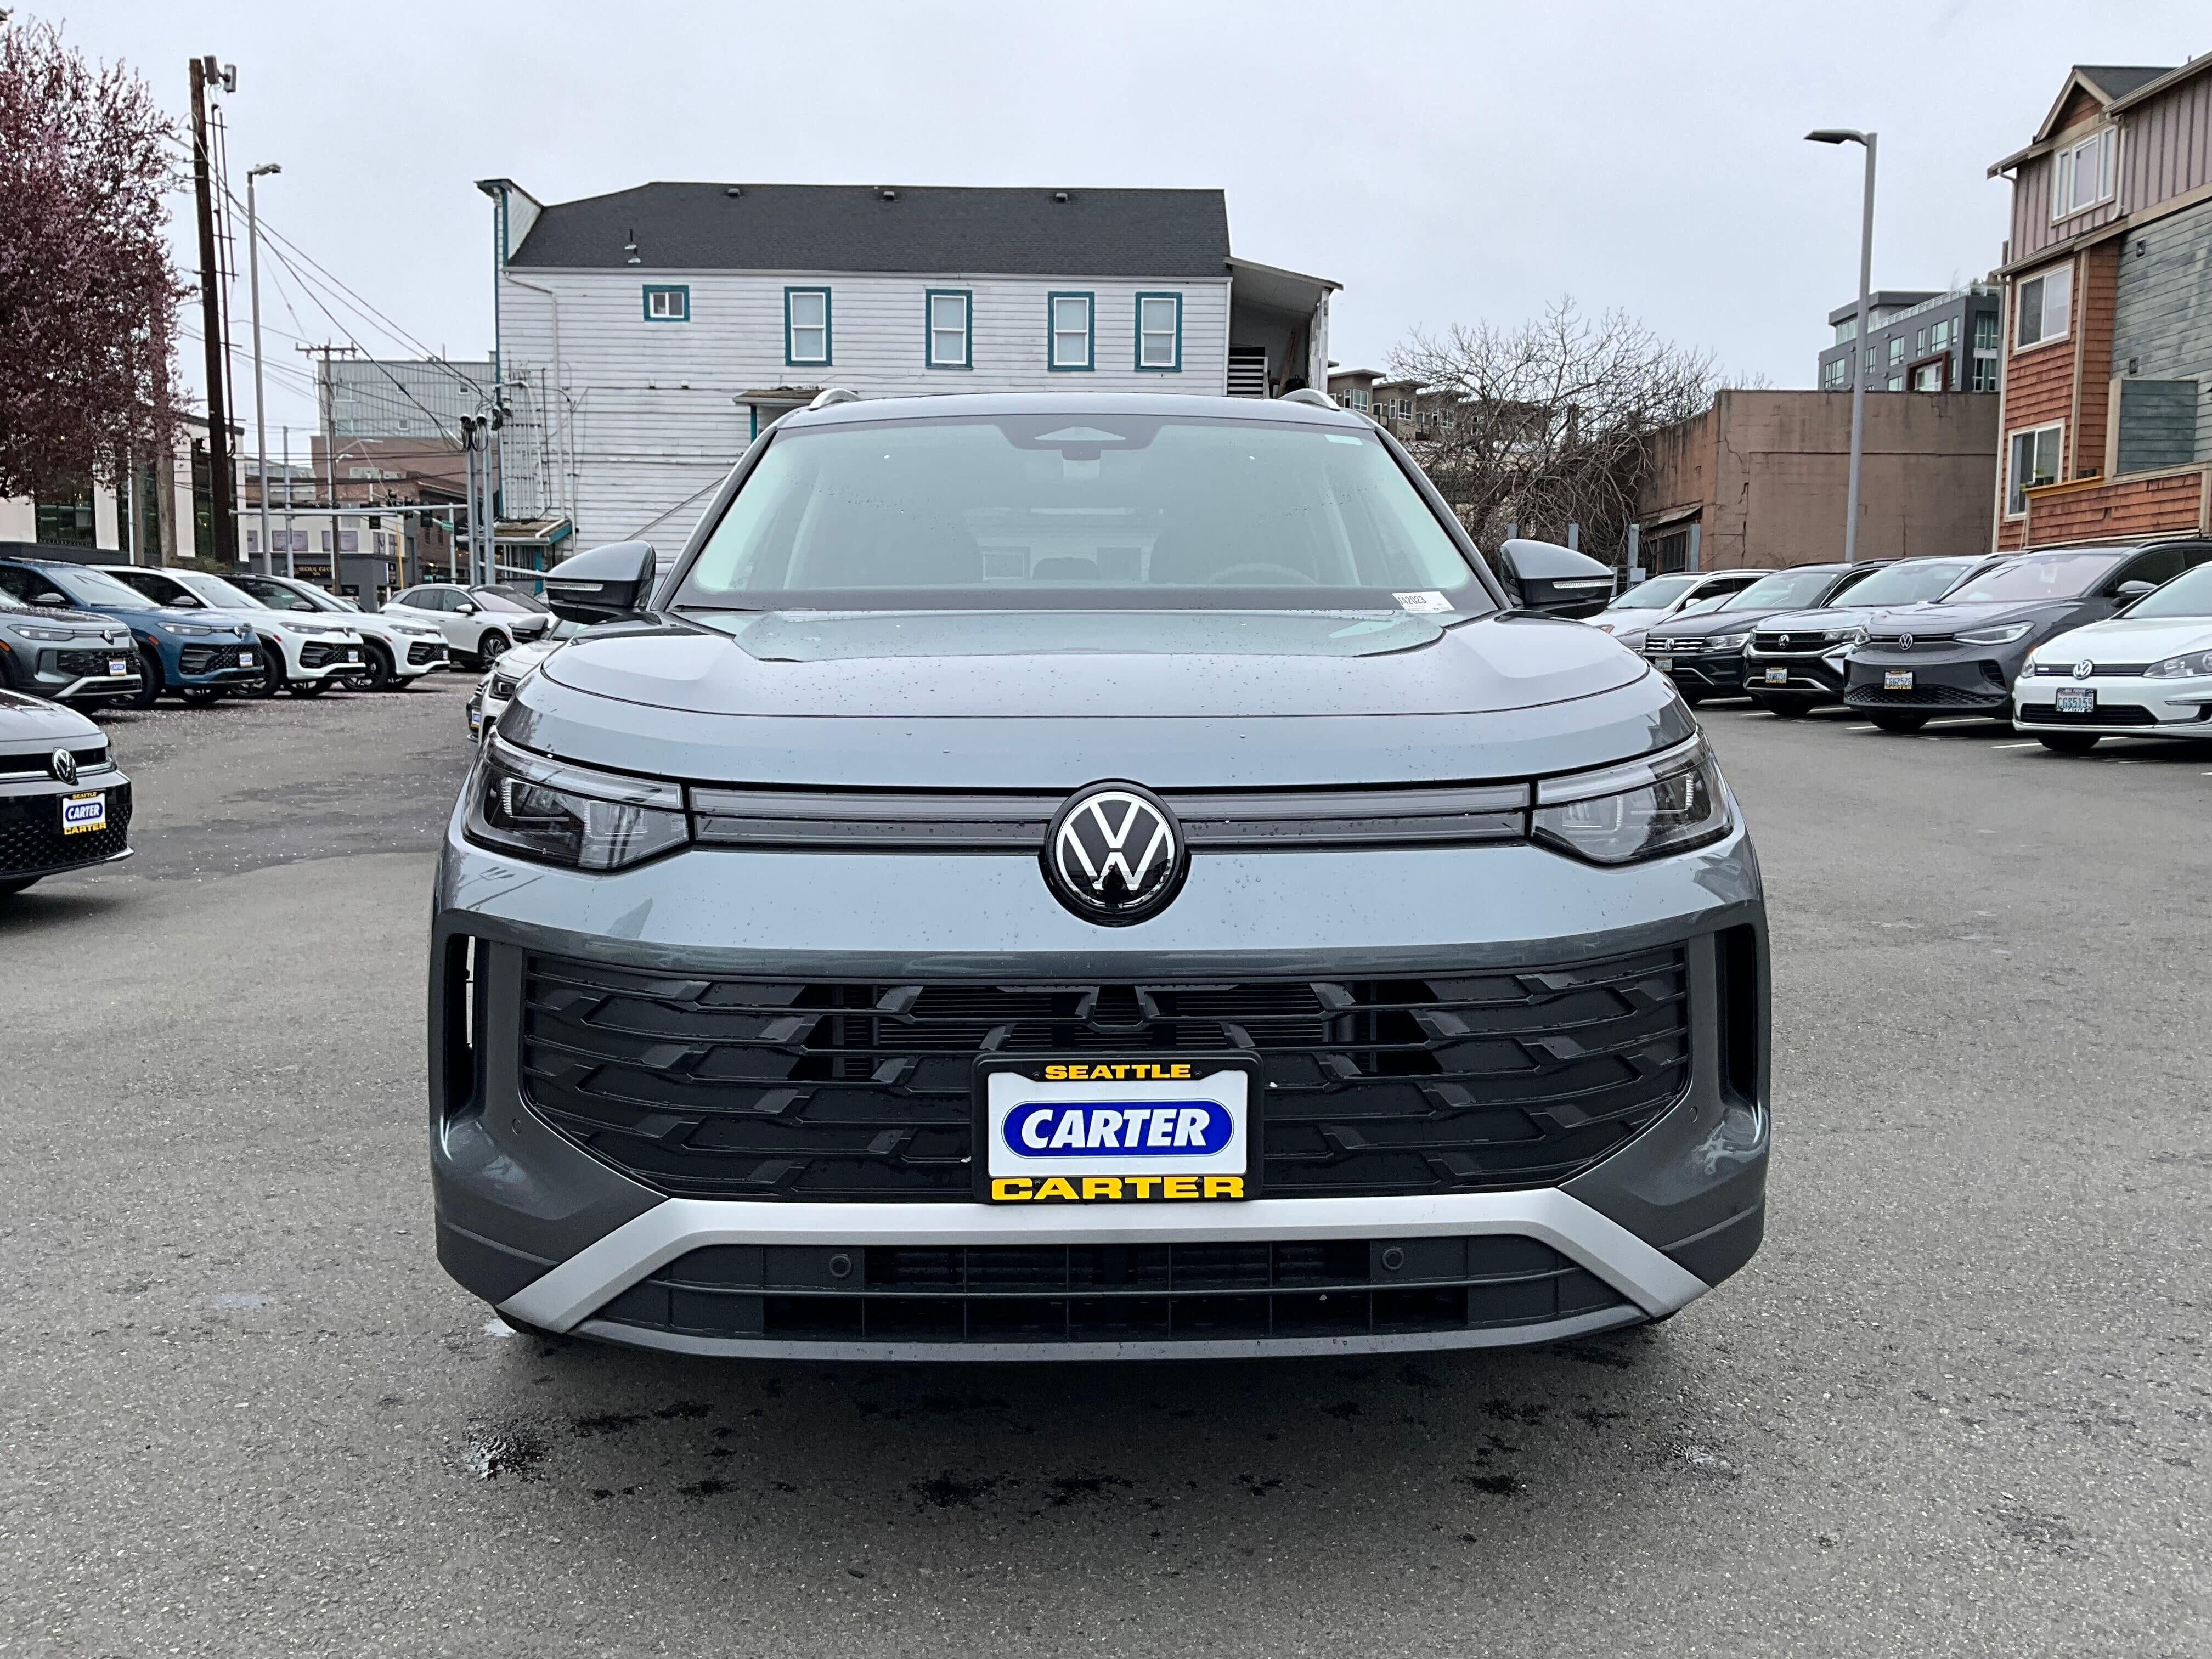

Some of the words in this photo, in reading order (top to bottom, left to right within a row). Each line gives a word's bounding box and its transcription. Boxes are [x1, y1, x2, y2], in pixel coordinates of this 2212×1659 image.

[1899, 633, 1913, 650] VW
[2073, 660, 2092, 679] VW
[54, 749, 76, 783] VW
[68, 804, 100, 820] CARTER
[64, 822, 106, 835] CARTER
[1056, 791, 1175, 909] VW
[1045, 1064, 1191, 1080] SEATTLE
[1022, 1109, 1210, 1149] CARTER
[991, 1176, 1244, 1200] CARTER
